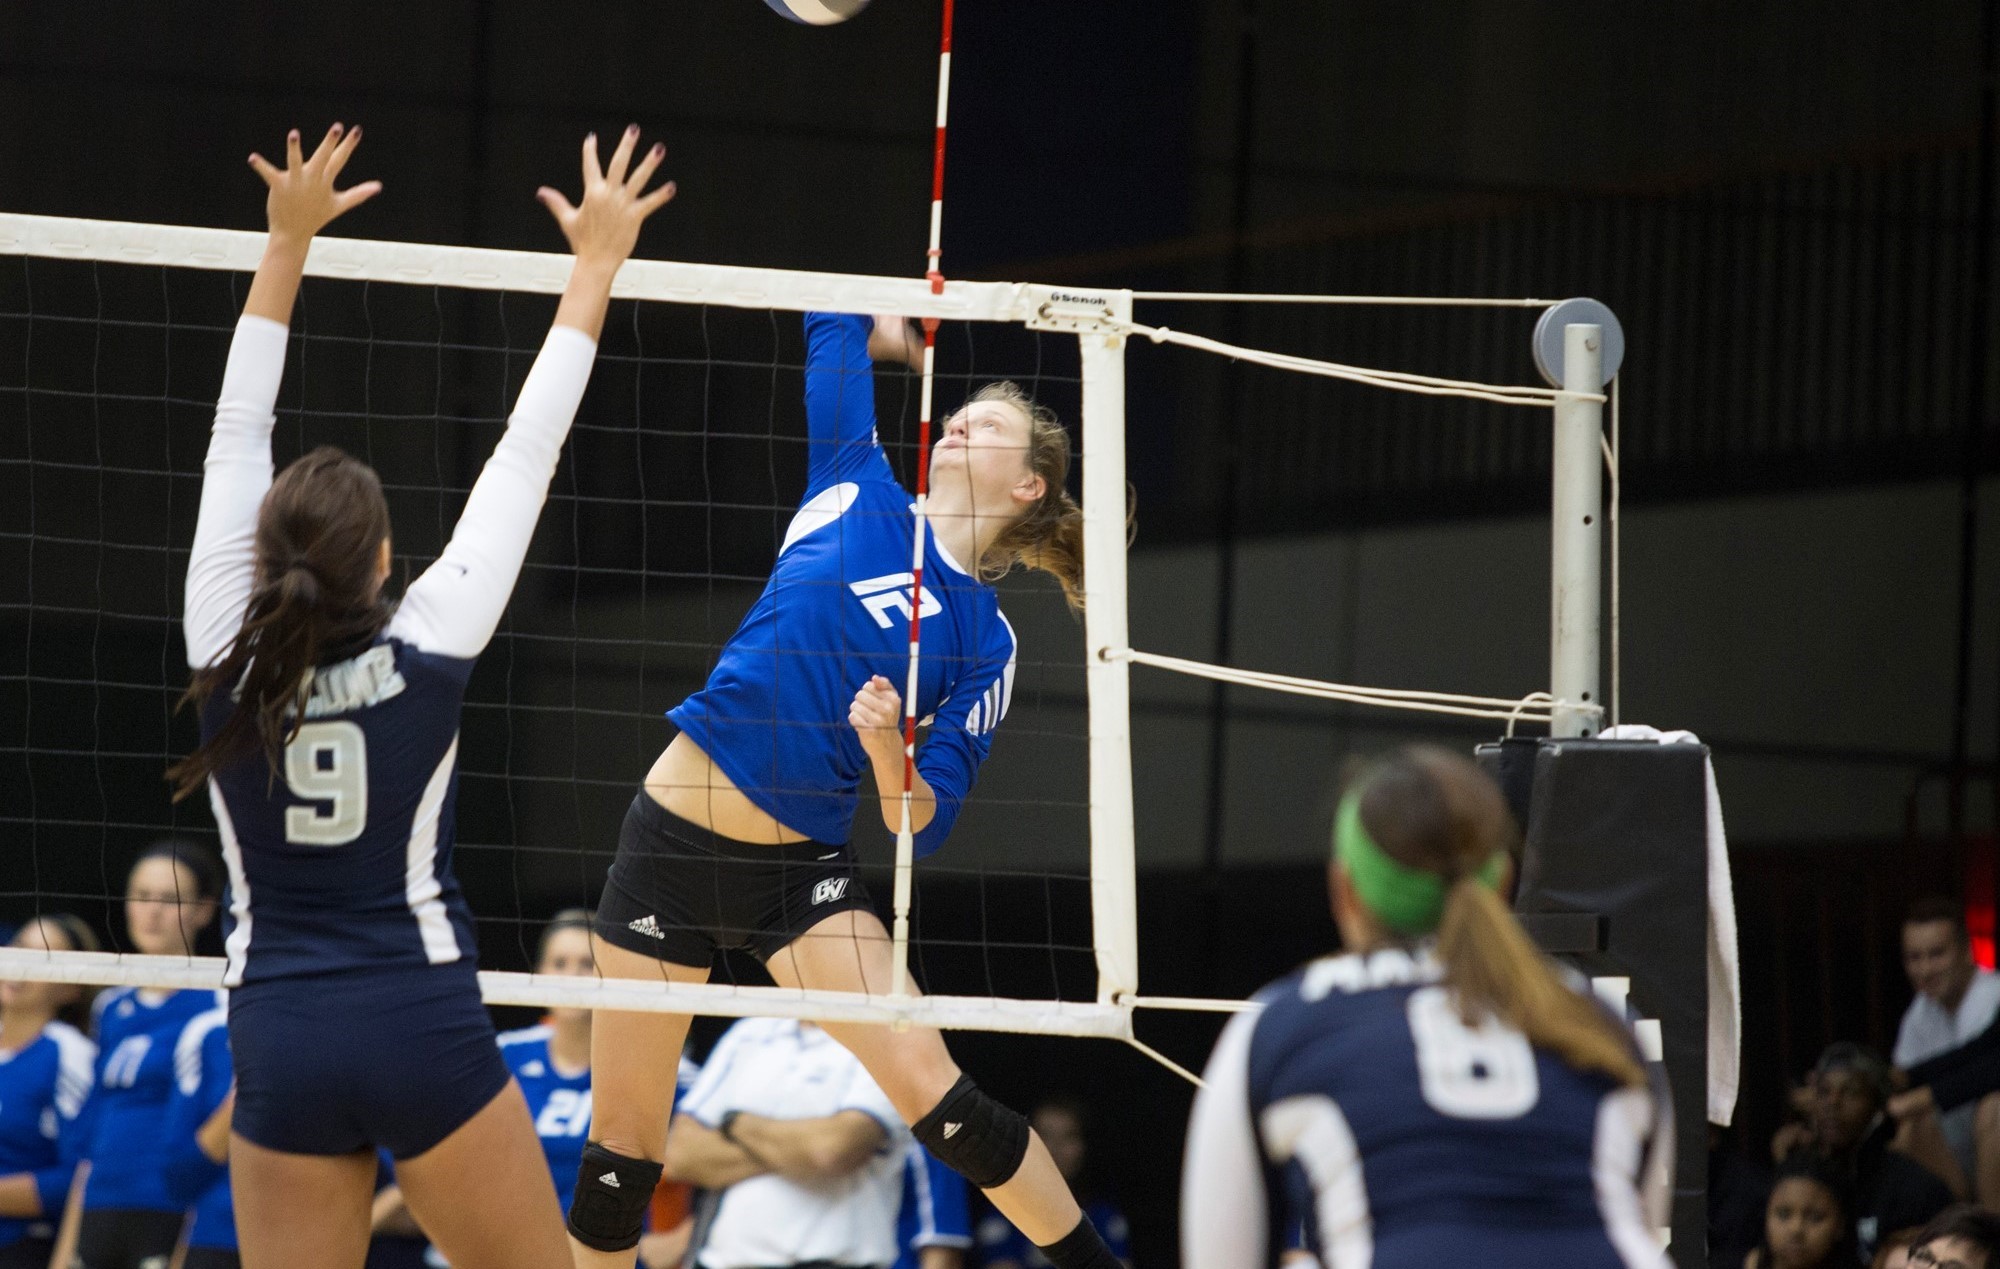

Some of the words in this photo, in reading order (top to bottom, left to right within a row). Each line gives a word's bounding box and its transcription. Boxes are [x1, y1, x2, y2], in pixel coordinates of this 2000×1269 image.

[848, 572, 943, 629] 12
[284, 720, 369, 847] 9
[811, 877, 850, 905] GV
[1406, 985, 1541, 1121] 6
[536, 1088, 592, 1137] 21
